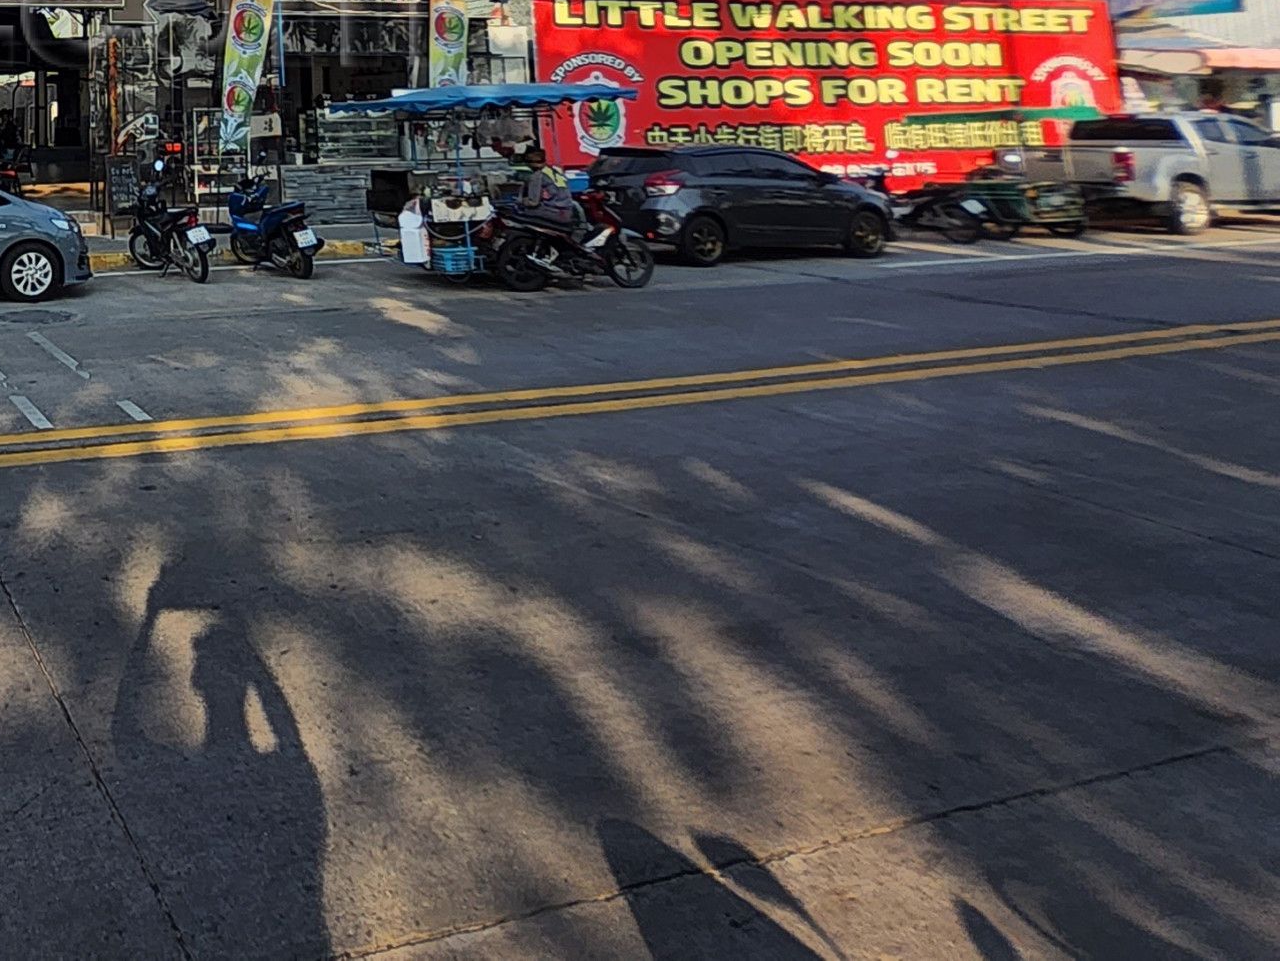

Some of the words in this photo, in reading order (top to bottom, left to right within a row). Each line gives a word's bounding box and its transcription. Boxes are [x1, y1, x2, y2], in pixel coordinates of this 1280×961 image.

[730, 0, 936, 33] WALKING
[944, 7, 1094, 34] STREET
[550, 53, 626, 84] SPONSORED
[624, 66, 645, 83] BY
[681, 39, 878, 69] OPENING
[886, 41, 1003, 69] SOON
[658, 76, 814, 107] SHOPS
[822, 77, 908, 106] FOR
[915, 78, 1026, 105] RENT
